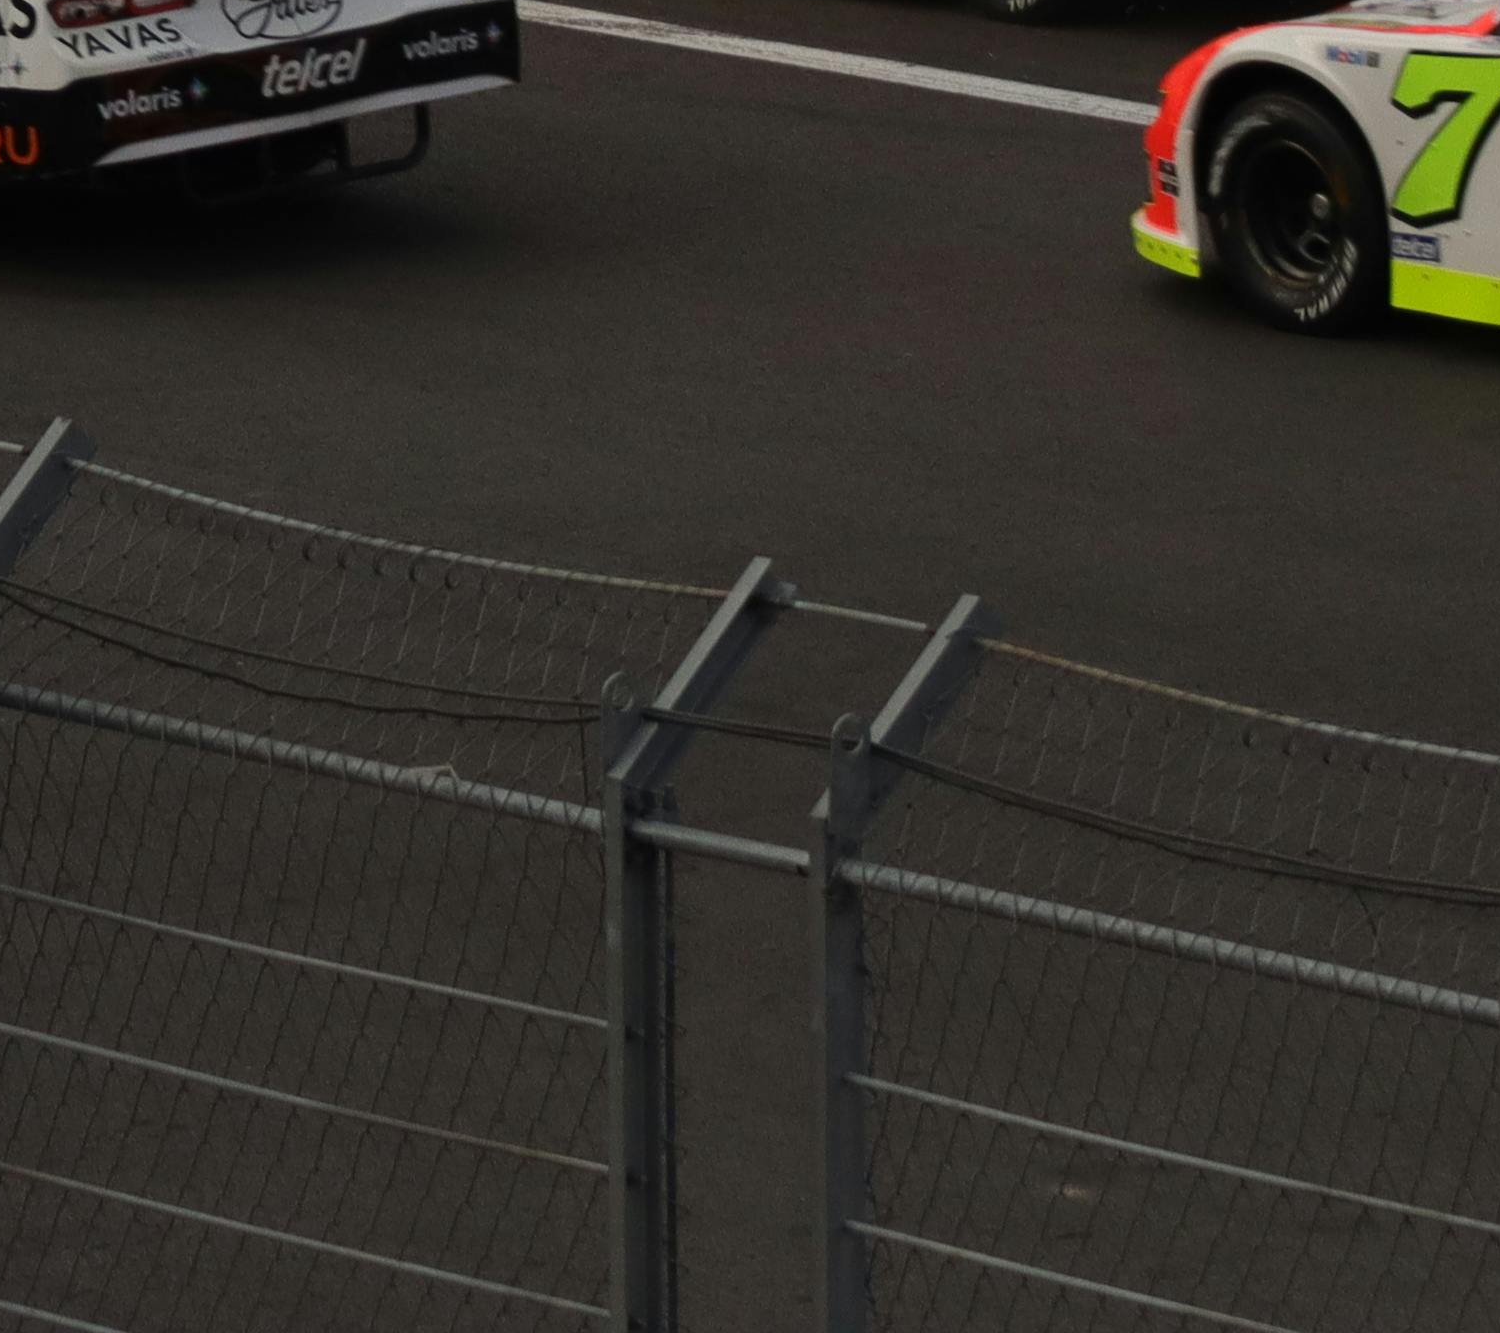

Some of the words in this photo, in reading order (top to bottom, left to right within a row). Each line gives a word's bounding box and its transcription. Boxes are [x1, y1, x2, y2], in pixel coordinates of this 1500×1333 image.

[401, 26, 479, 64] volaris
[259, 38, 367, 99] telcel
[97, 84, 183, 122] volaris
